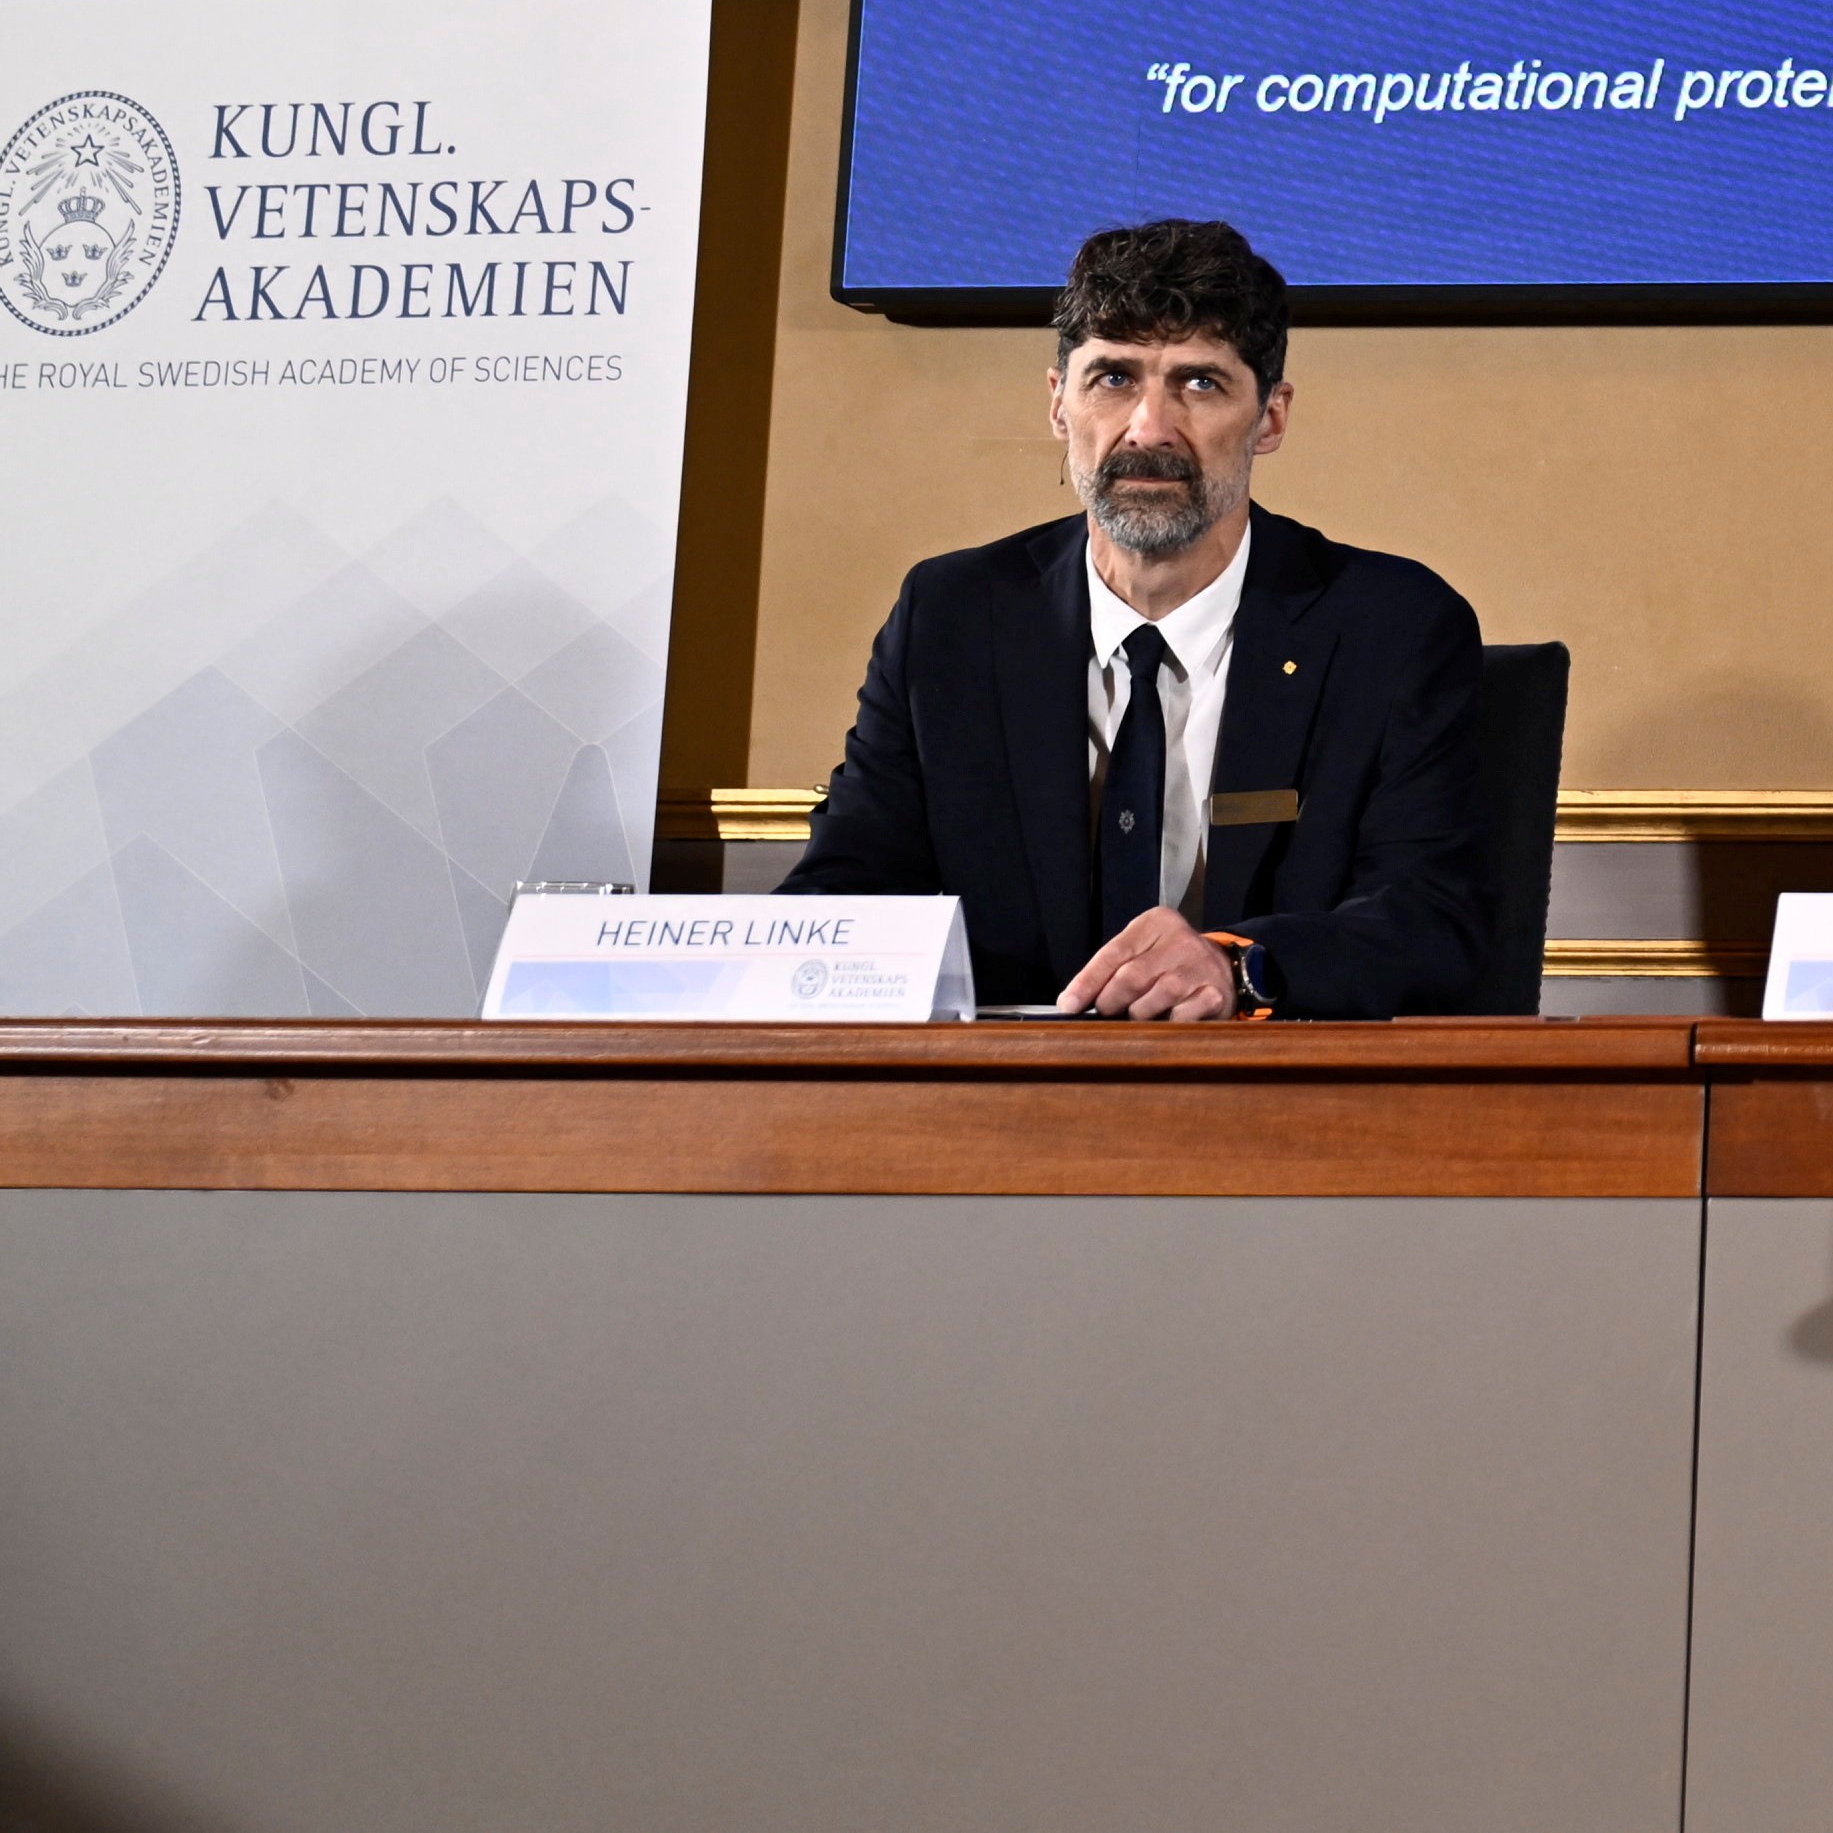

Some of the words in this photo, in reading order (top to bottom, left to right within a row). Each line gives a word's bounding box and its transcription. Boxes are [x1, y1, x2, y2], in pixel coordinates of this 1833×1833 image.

[1147, 63, 1244, 112] “for
[1257, 59, 1664, 123] computational
[208, 101, 455, 158] KUNGL.
[5, 103, 170, 266] VETENSKAPSAKADEMIEN
[204, 178, 651, 240] VETENSKAPS-
[0, 180, 16, 267] KUNGL.
[191, 261, 634, 321] AKADEMIEN
[0, 363, 28, 389] HE
[39, 363, 127, 388] ROYAL
[138, 360, 269, 387] SWEDISH
[279, 358, 420, 385] ACADEMY
[430, 357, 466, 383] OF
[475, 355, 622, 382] SCIENCES
[597, 921, 733, 945] HEINER
[745, 920, 853, 945] LINKE
